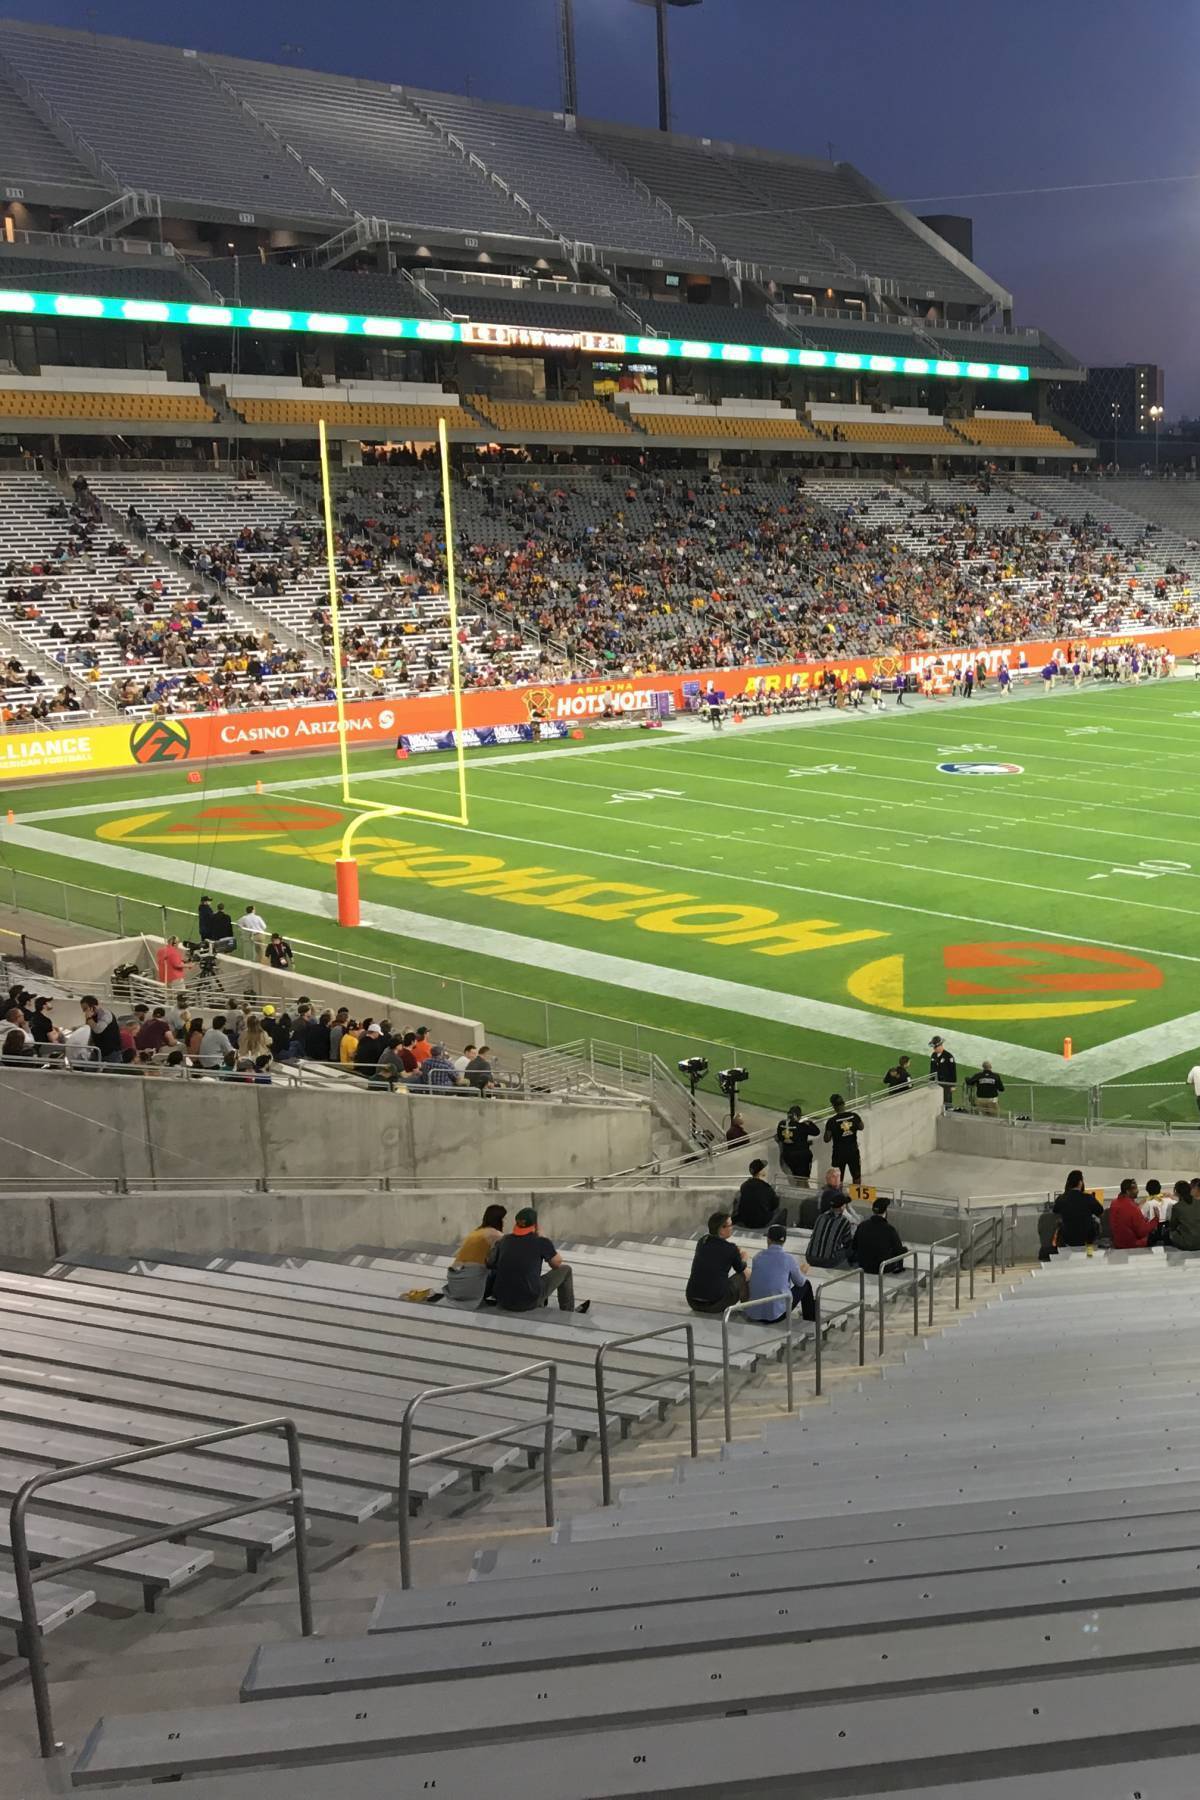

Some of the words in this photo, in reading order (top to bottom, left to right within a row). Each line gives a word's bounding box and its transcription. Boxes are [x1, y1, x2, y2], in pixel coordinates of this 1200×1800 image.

[221, 726, 289, 743] CASINO
[1112, 860, 1192, 879] 10
[855, 1187, 870, 1200] 15
